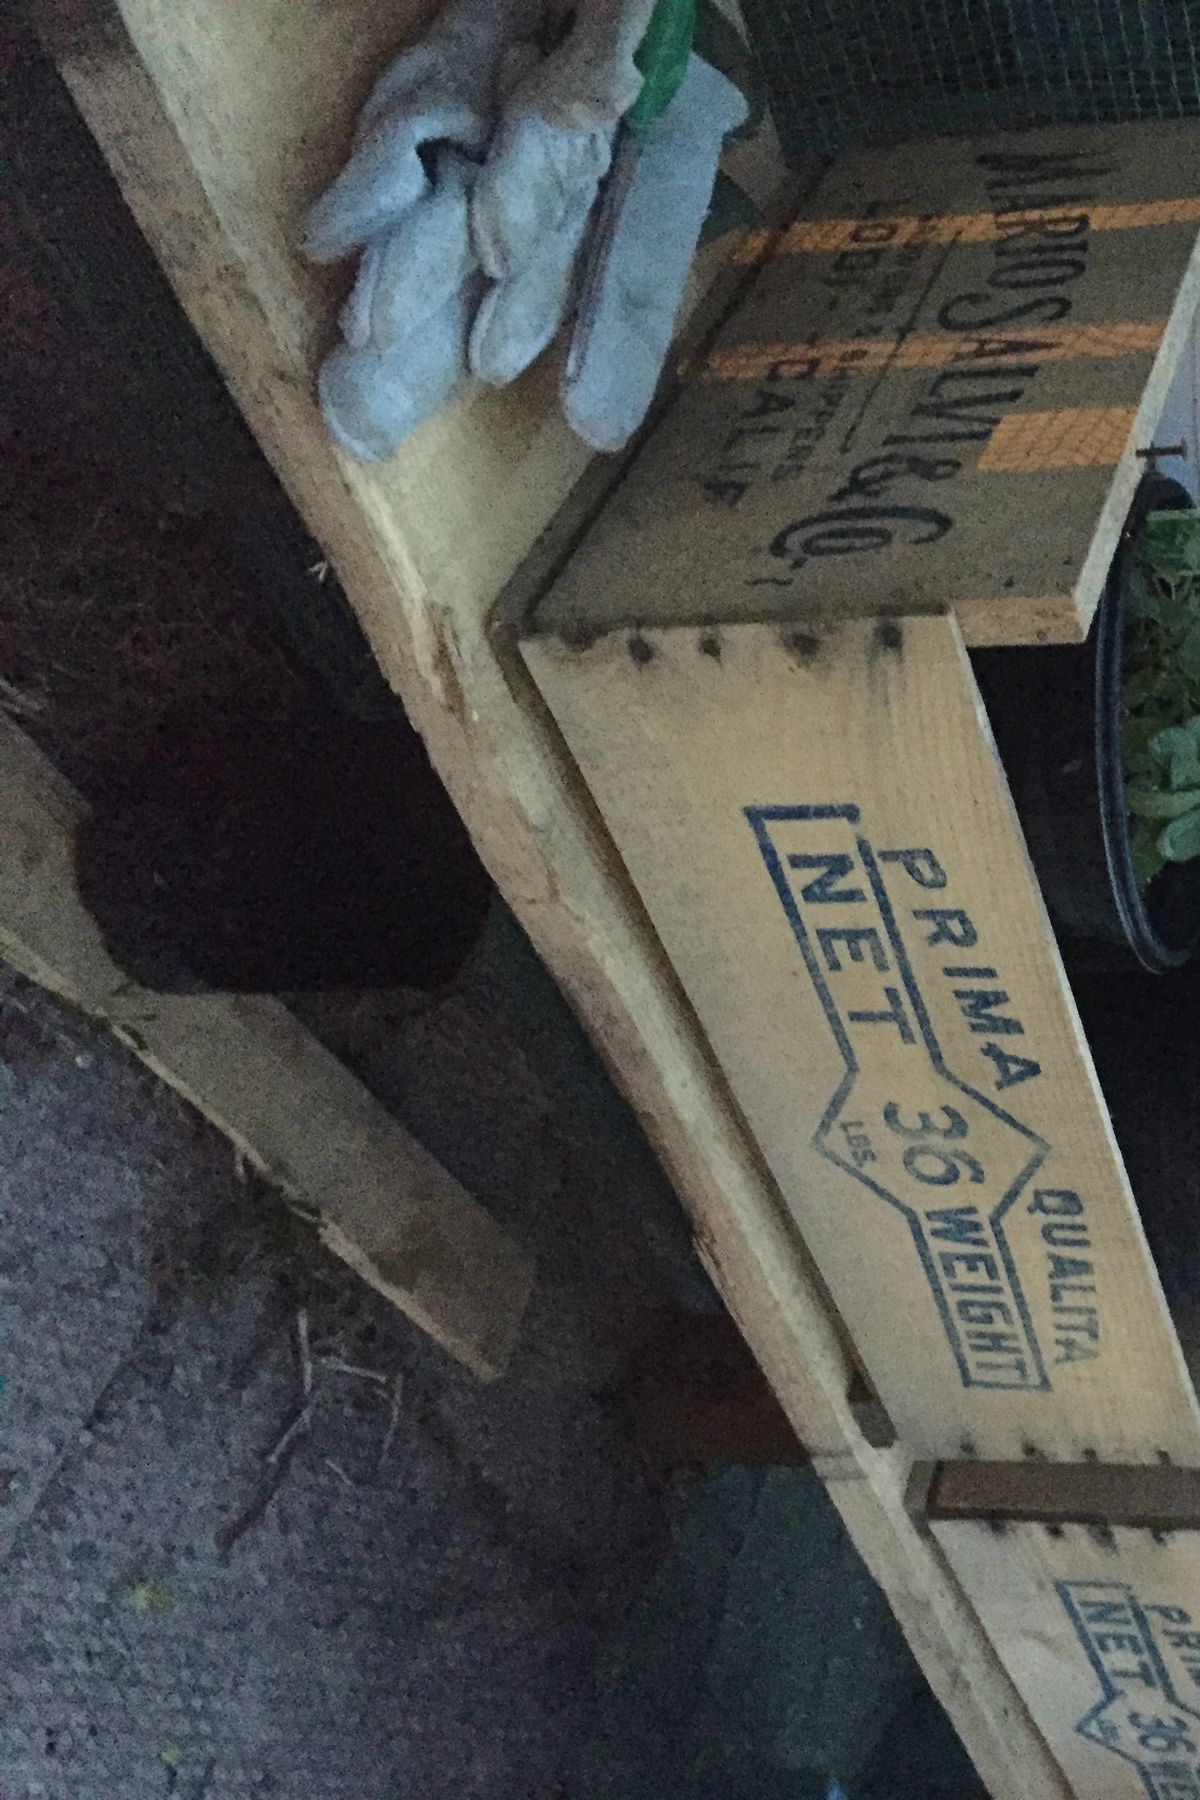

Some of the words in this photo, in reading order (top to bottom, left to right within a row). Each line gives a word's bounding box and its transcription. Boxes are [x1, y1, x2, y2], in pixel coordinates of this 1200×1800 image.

[975, 150, 1111, 289] MARIO
[884, 292, 1072, 446] SALVI
[833, 451, 962, 500] &
[786, 852, 919, 1046] NET
[877, 846, 1043, 1093] PRIMA
[1025, 1186, 1101, 1366] QUALITA
[883, 1100, 985, 1188] 36
[925, 1202, 1038, 1385] WEIGHT
[1077, 1601, 1157, 1689] NET
[1127, 1711, 1198, 1753] 36
